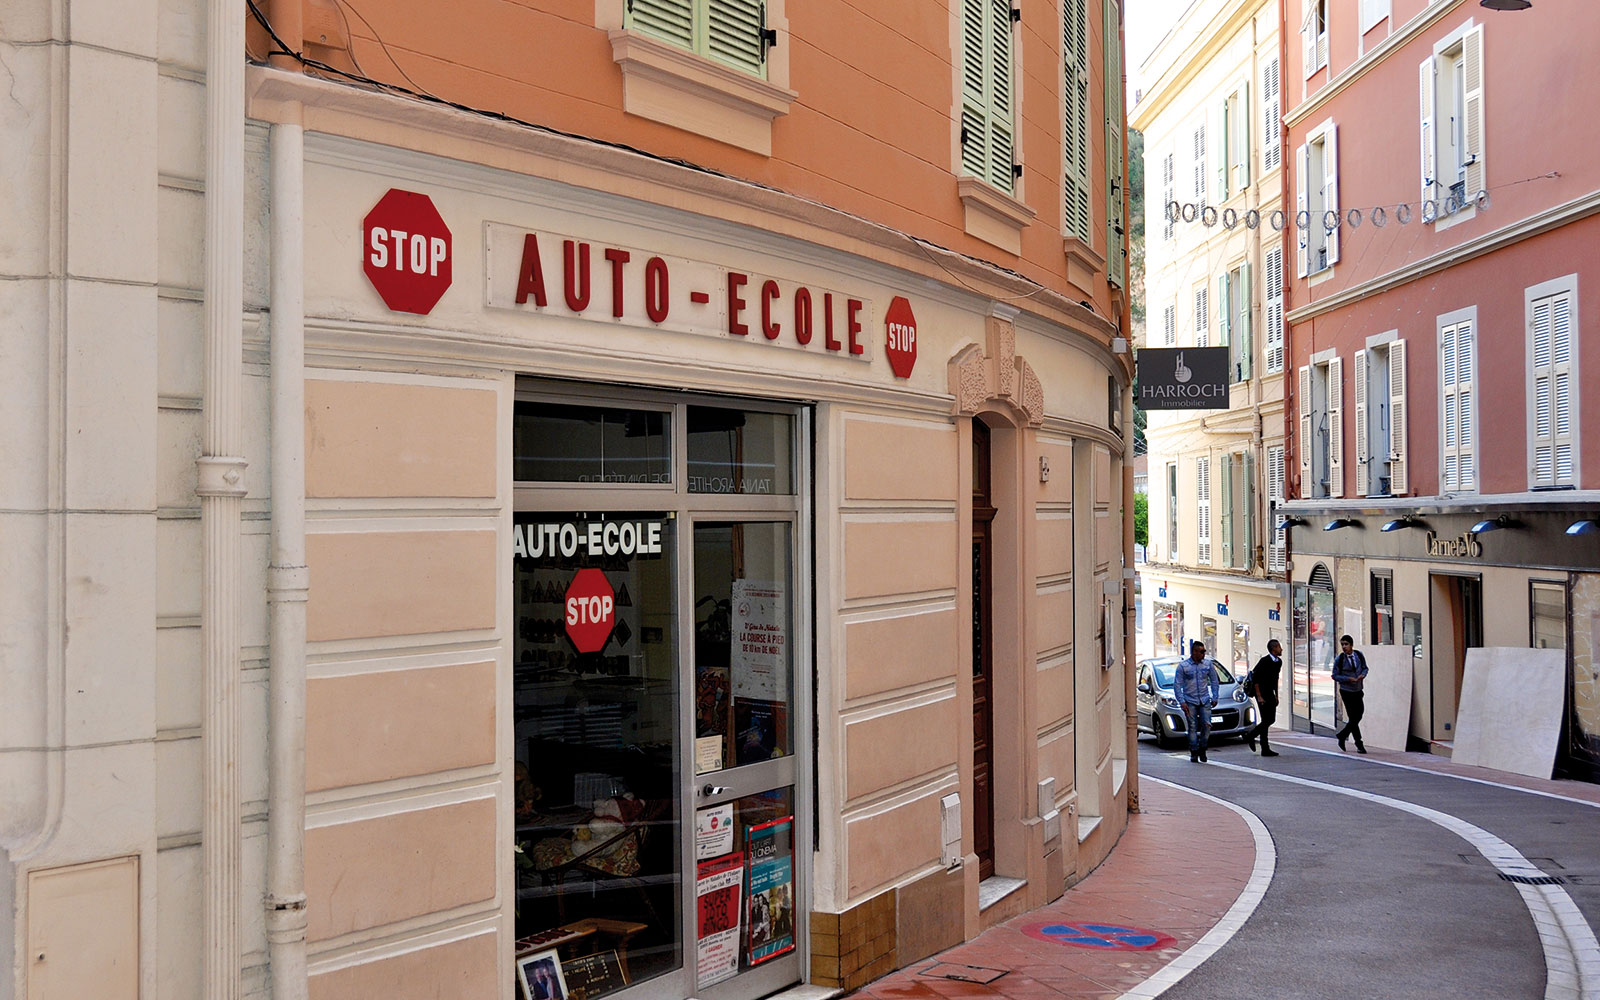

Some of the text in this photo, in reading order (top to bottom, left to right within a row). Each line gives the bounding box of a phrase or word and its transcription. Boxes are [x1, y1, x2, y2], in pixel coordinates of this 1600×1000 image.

[370, 227, 447, 277] STOP
[888, 322, 916, 353] STOP
[1142, 384, 1225, 398] HARROCH
[1161, 400, 1206, 408] Immobilier
[513, 522, 662, 558] AUTO-ECOLE
[1424, 530, 1460, 557] Carnet
[567, 596, 613, 627] STOP
[740, 632, 746, 642] LA
[747, 632, 766, 643] COURSE
[772, 634, 784, 644] PIED
[742, 644, 748, 652] DE
[762, 645, 768, 654] DE
[704, 888, 731, 909] SUPER
[706, 904, 727, 921] LOTO
[703, 916, 729, 936] BINGO
